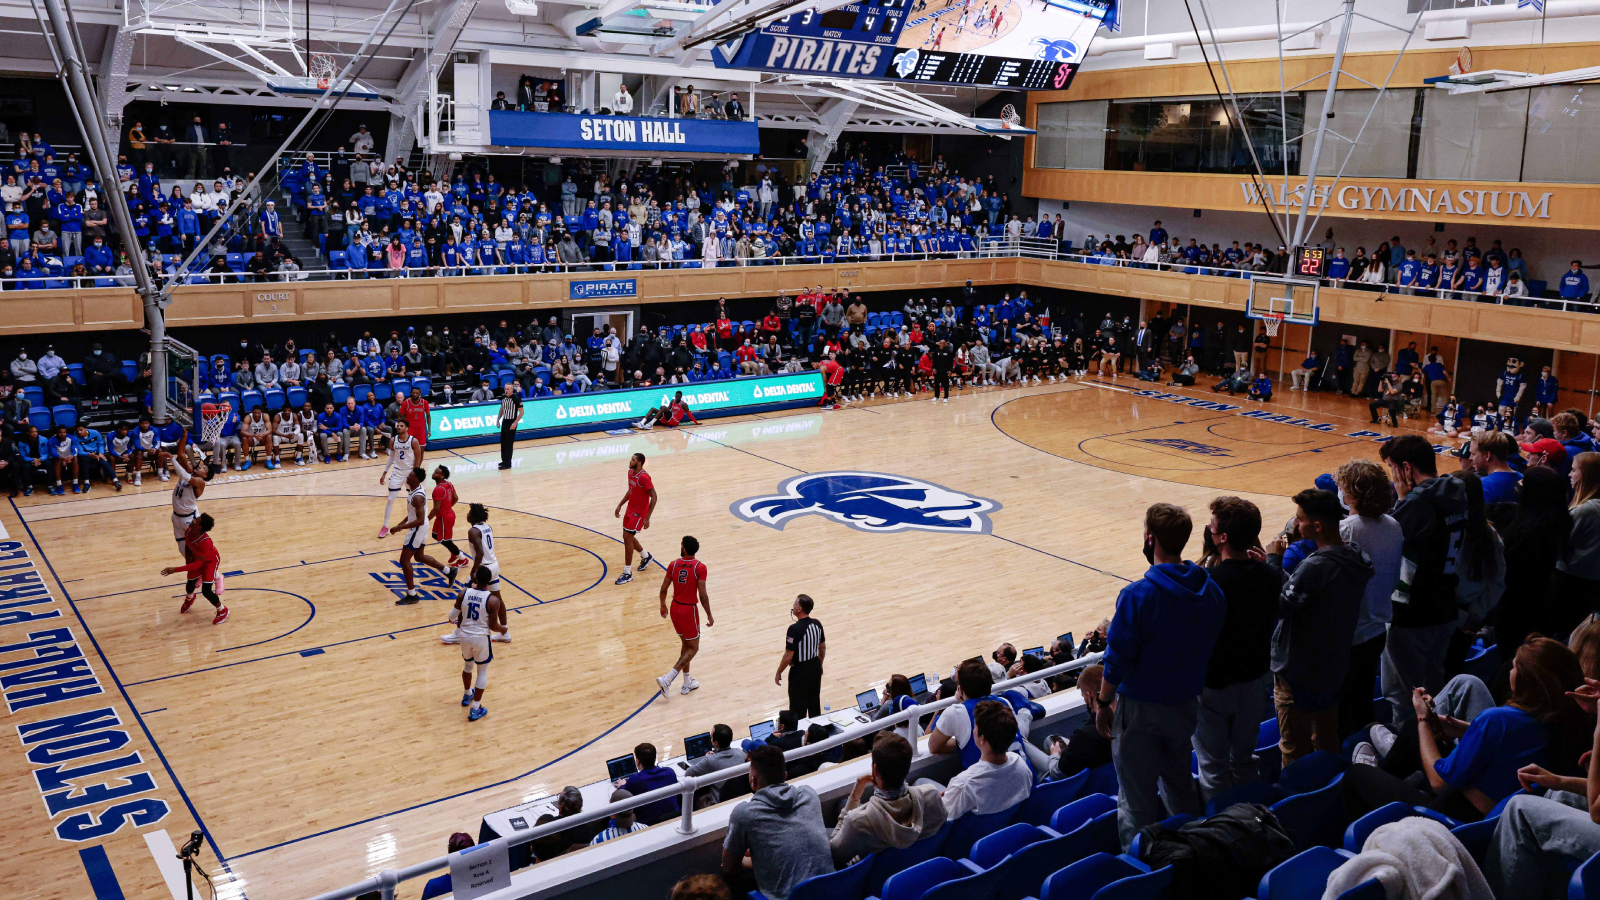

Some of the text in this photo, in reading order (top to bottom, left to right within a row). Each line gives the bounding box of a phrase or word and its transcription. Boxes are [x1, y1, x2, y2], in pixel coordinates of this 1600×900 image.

[886, 9, 904, 18] FOULS
[770, 24, 790, 34] SCORE
[865, 16, 876, 30] 4
[890, 18, 898, 32] 7
[822, 30, 842, 38] MATCH
[874, 35, 893, 43] SCORE
[766, 36, 882, 75] PIRATES
[580, 118, 686, 144] SETON HALL
[1240, 182, 1554, 218] WALSH GYMNASIUM
[1301, 258, 1319, 274] 22
[586, 282, 633, 291] PIRATE
[258, 292, 290, 302] COURT
[272, 304, 277, 312] 3
[763, 382, 816, 397] DELTA DENTAL
[698, 391, 730, 404] DENTAL
[568, 401, 631, 418] DELTA DENTAL
[1131, 389, 1338, 432] SETON HALL
[454, 416, 484, 430] DELTA
[400, 451, 405, 460] 2
[175, 486, 184, 499] 14
[486, 534, 493, 550] 0
[678, 569, 688, 584] 2
[467, 602, 480, 621] 15
[0, 626, 105, 714] HALL
[16, 706, 172, 842] SETON
[469, 861, 487, 870] Section
[470, 878, 494, 889] Reserved
